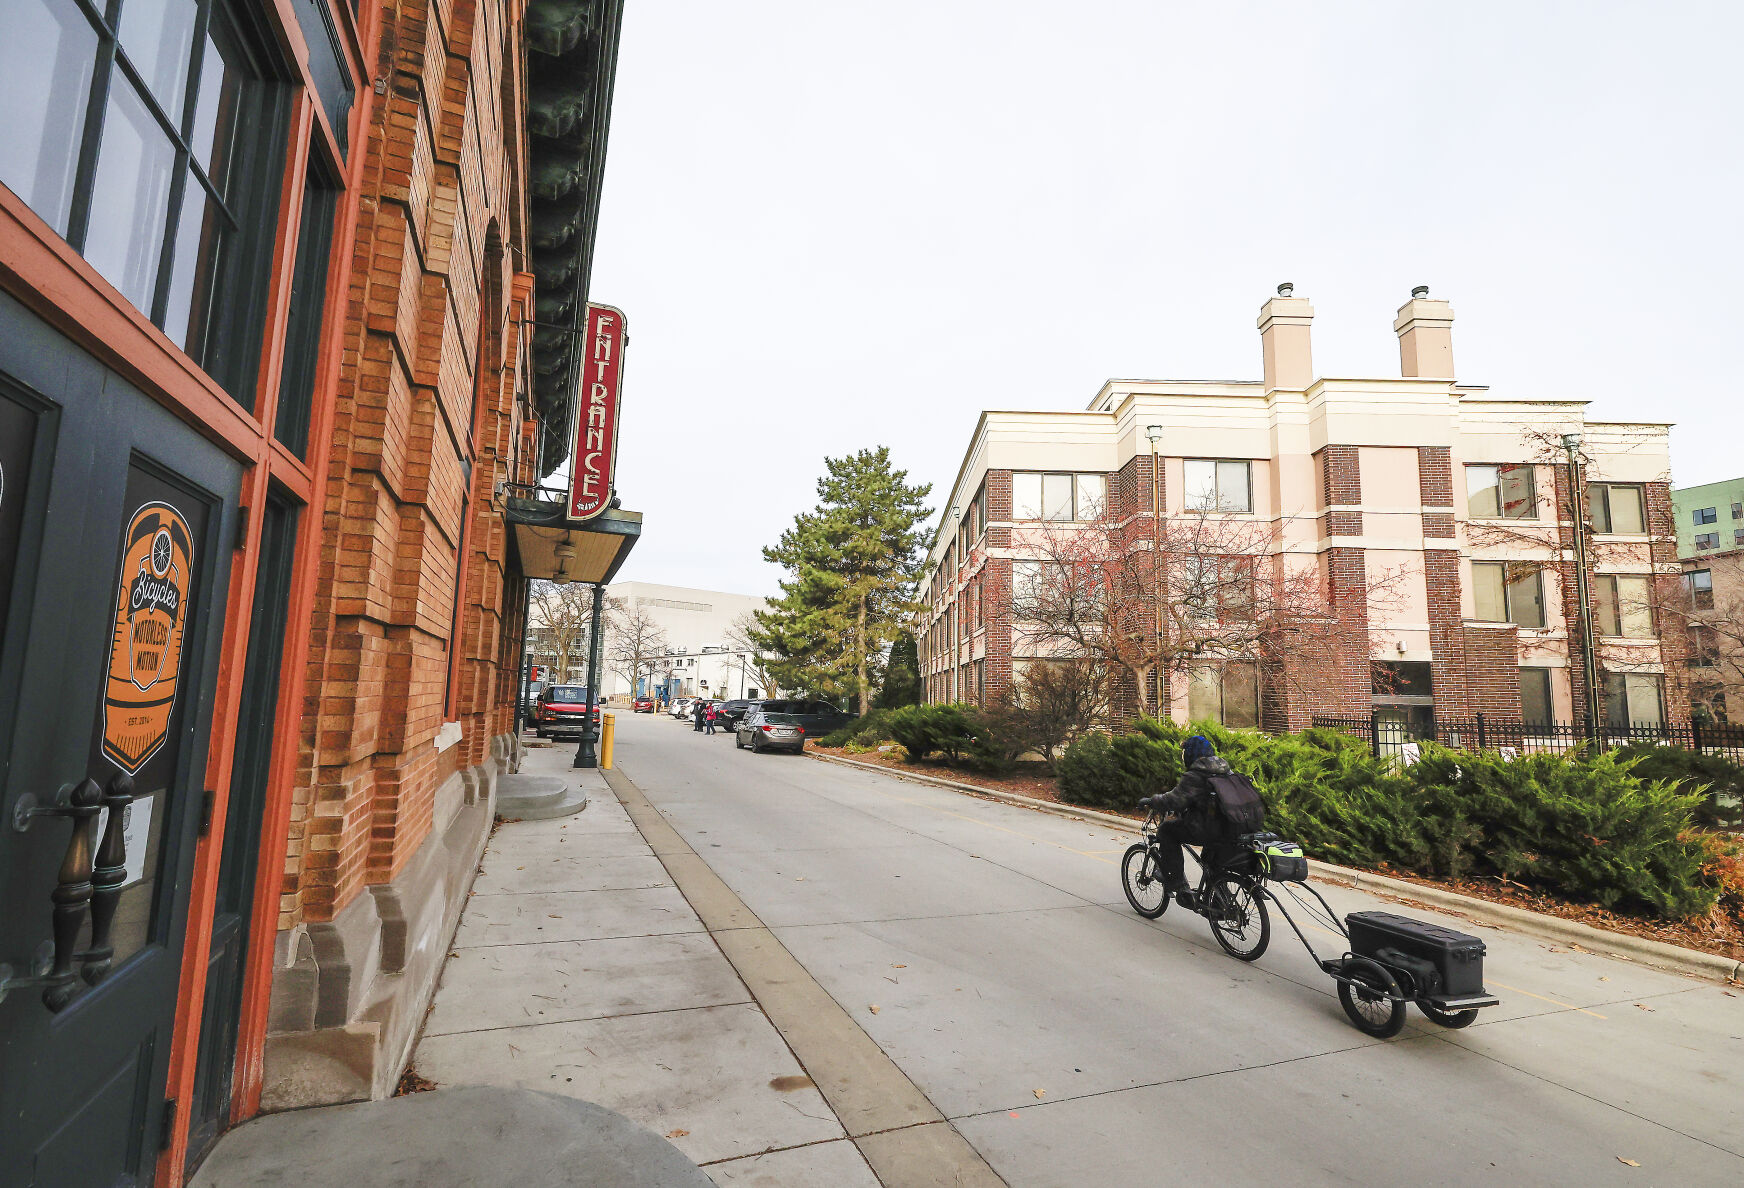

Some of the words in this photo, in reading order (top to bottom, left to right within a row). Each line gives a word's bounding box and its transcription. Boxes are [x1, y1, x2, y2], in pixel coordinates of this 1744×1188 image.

[582, 314, 614, 498] ENTRANCE
[132, 567, 178, 613] Bicycles
[133, 619, 168, 647] MOTORLESS
[135, 650, 160, 672] MOTION
